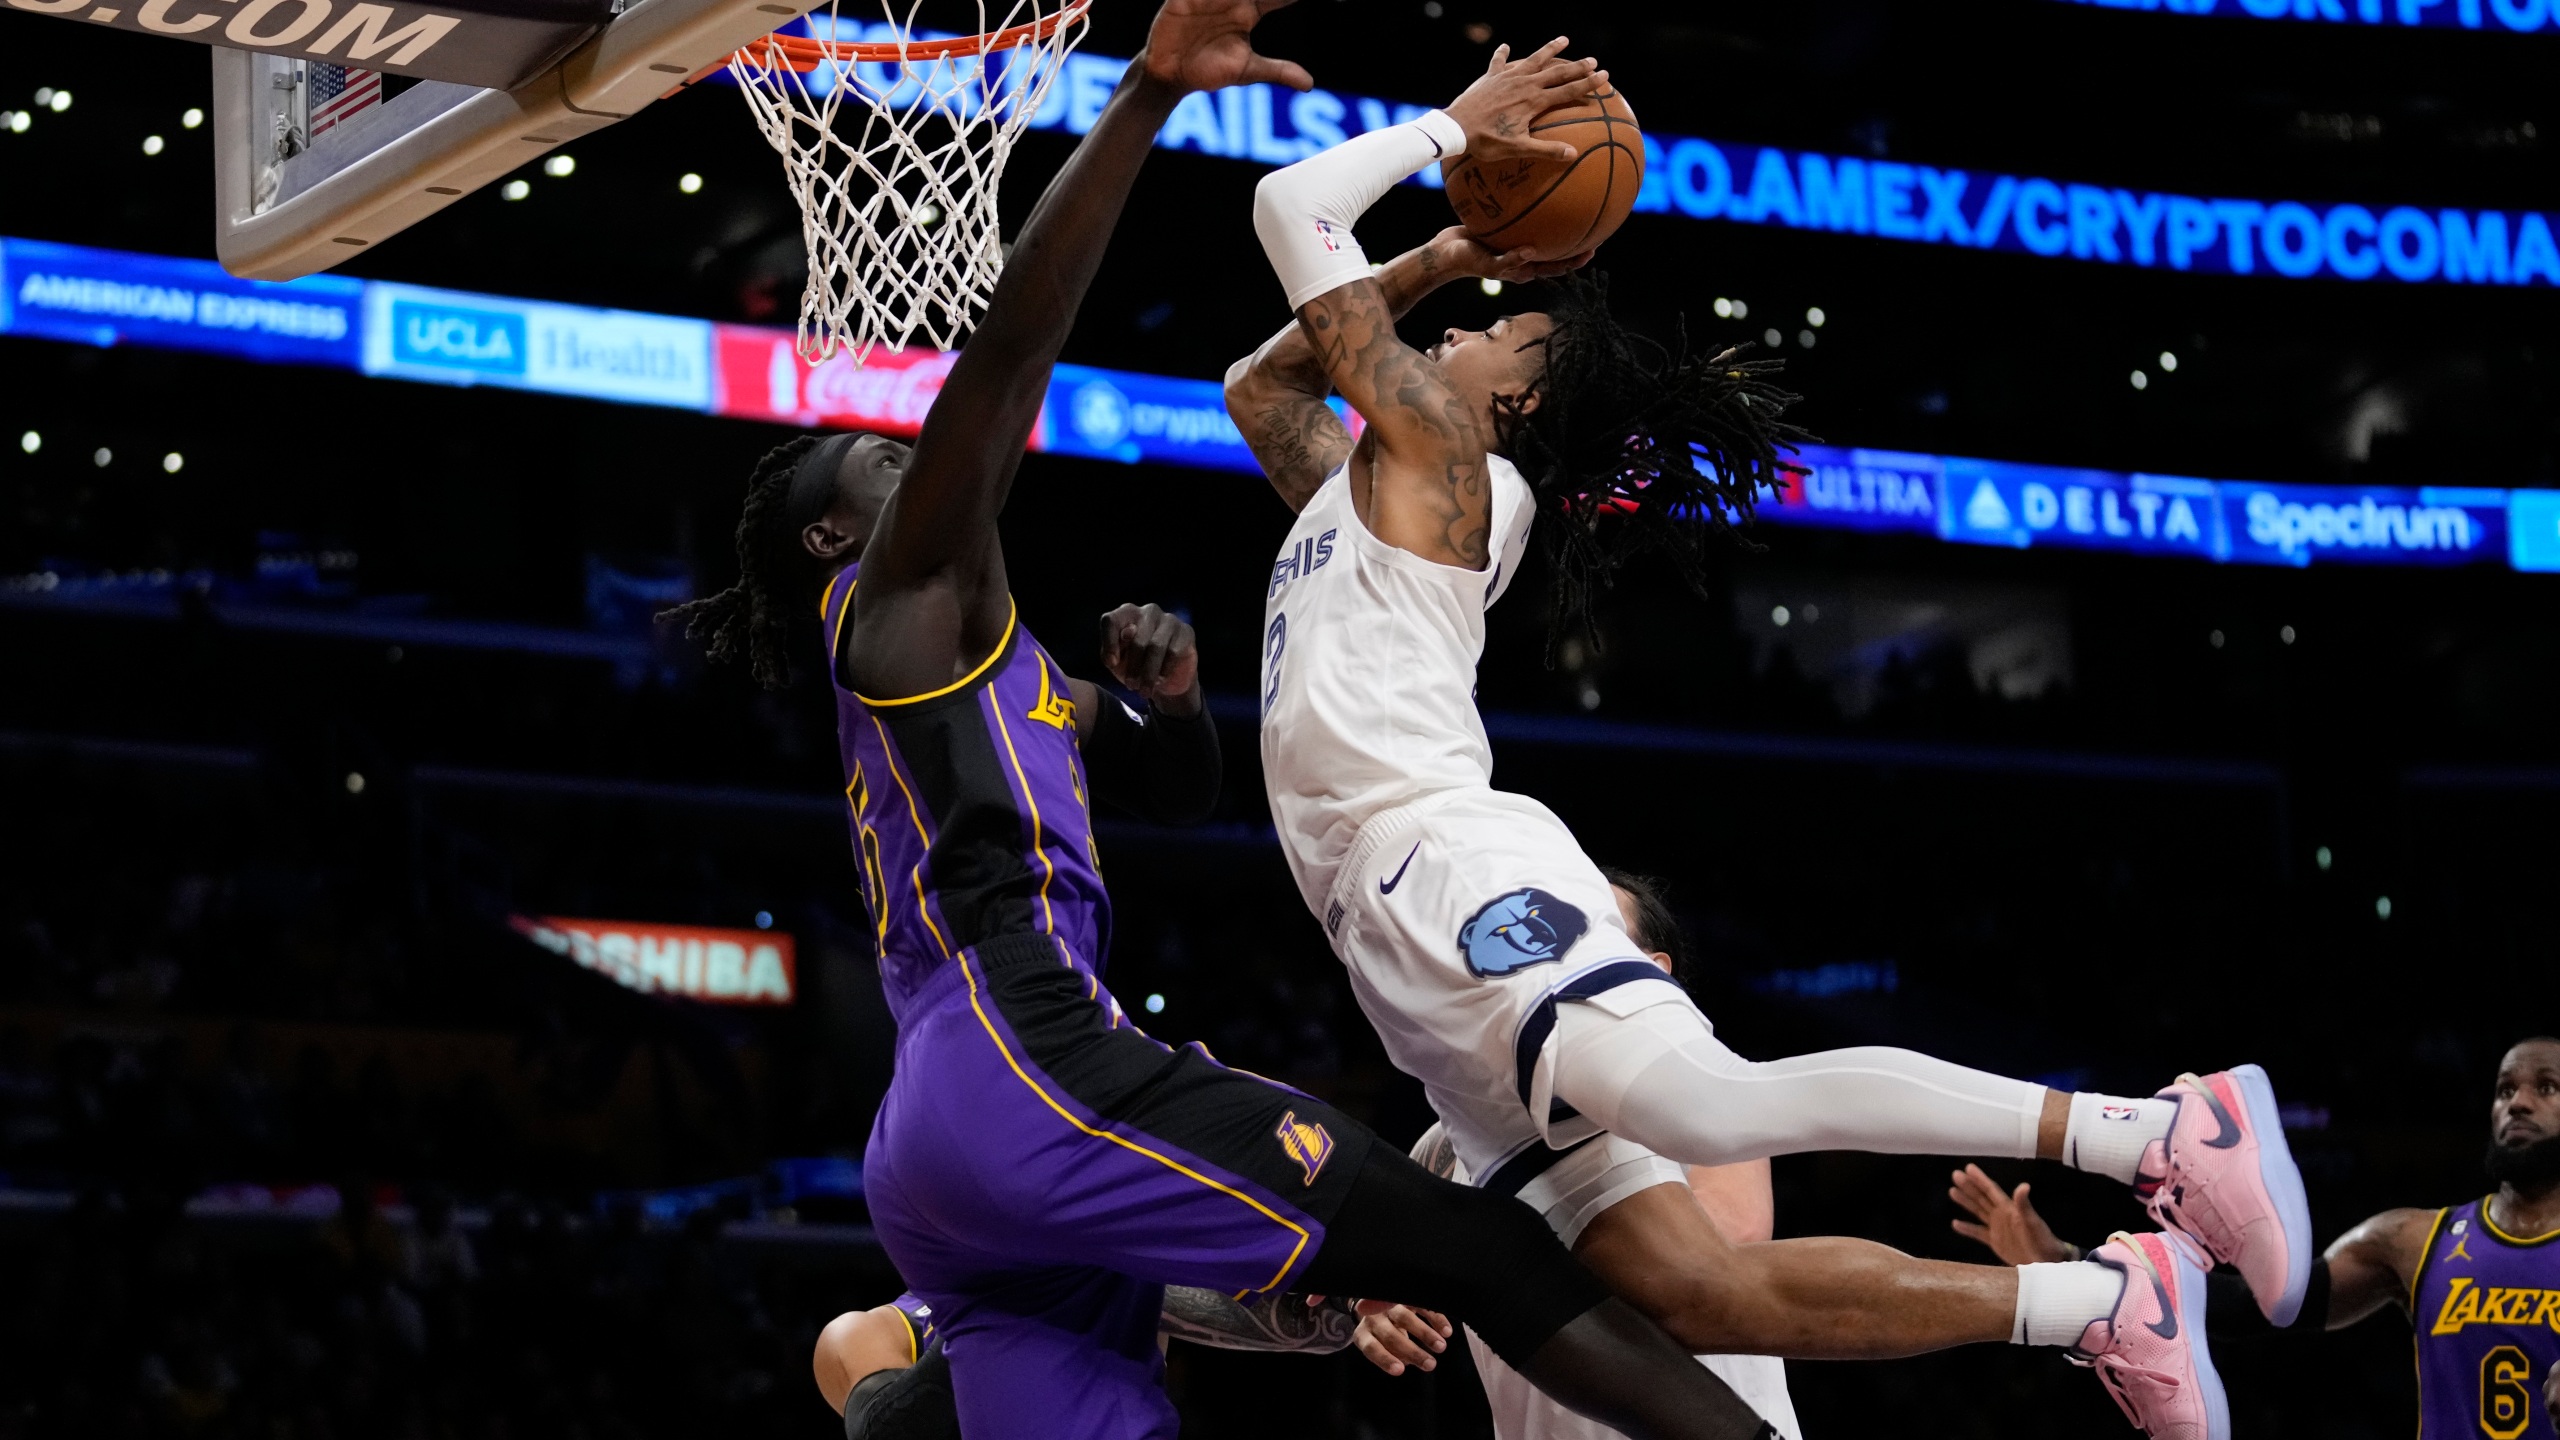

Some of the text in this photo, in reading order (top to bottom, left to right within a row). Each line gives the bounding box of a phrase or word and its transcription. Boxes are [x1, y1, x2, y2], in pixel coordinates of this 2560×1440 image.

[3, 0, 462, 66] .COM
[1003, 46, 1348, 166] DEAILS
[19, 273, 348, 341] AMERICAN EXPRESS
[408, 315, 692, 383] UCLA Health
[1802, 465, 1933, 516] ULTRA
[2021, 482, 2200, 542] DELTA
[2246, 491, 2471, 556] Spectrum
[1269, 527, 1337, 599] PHIS
[2480, 1346, 2530, 1440] 6
